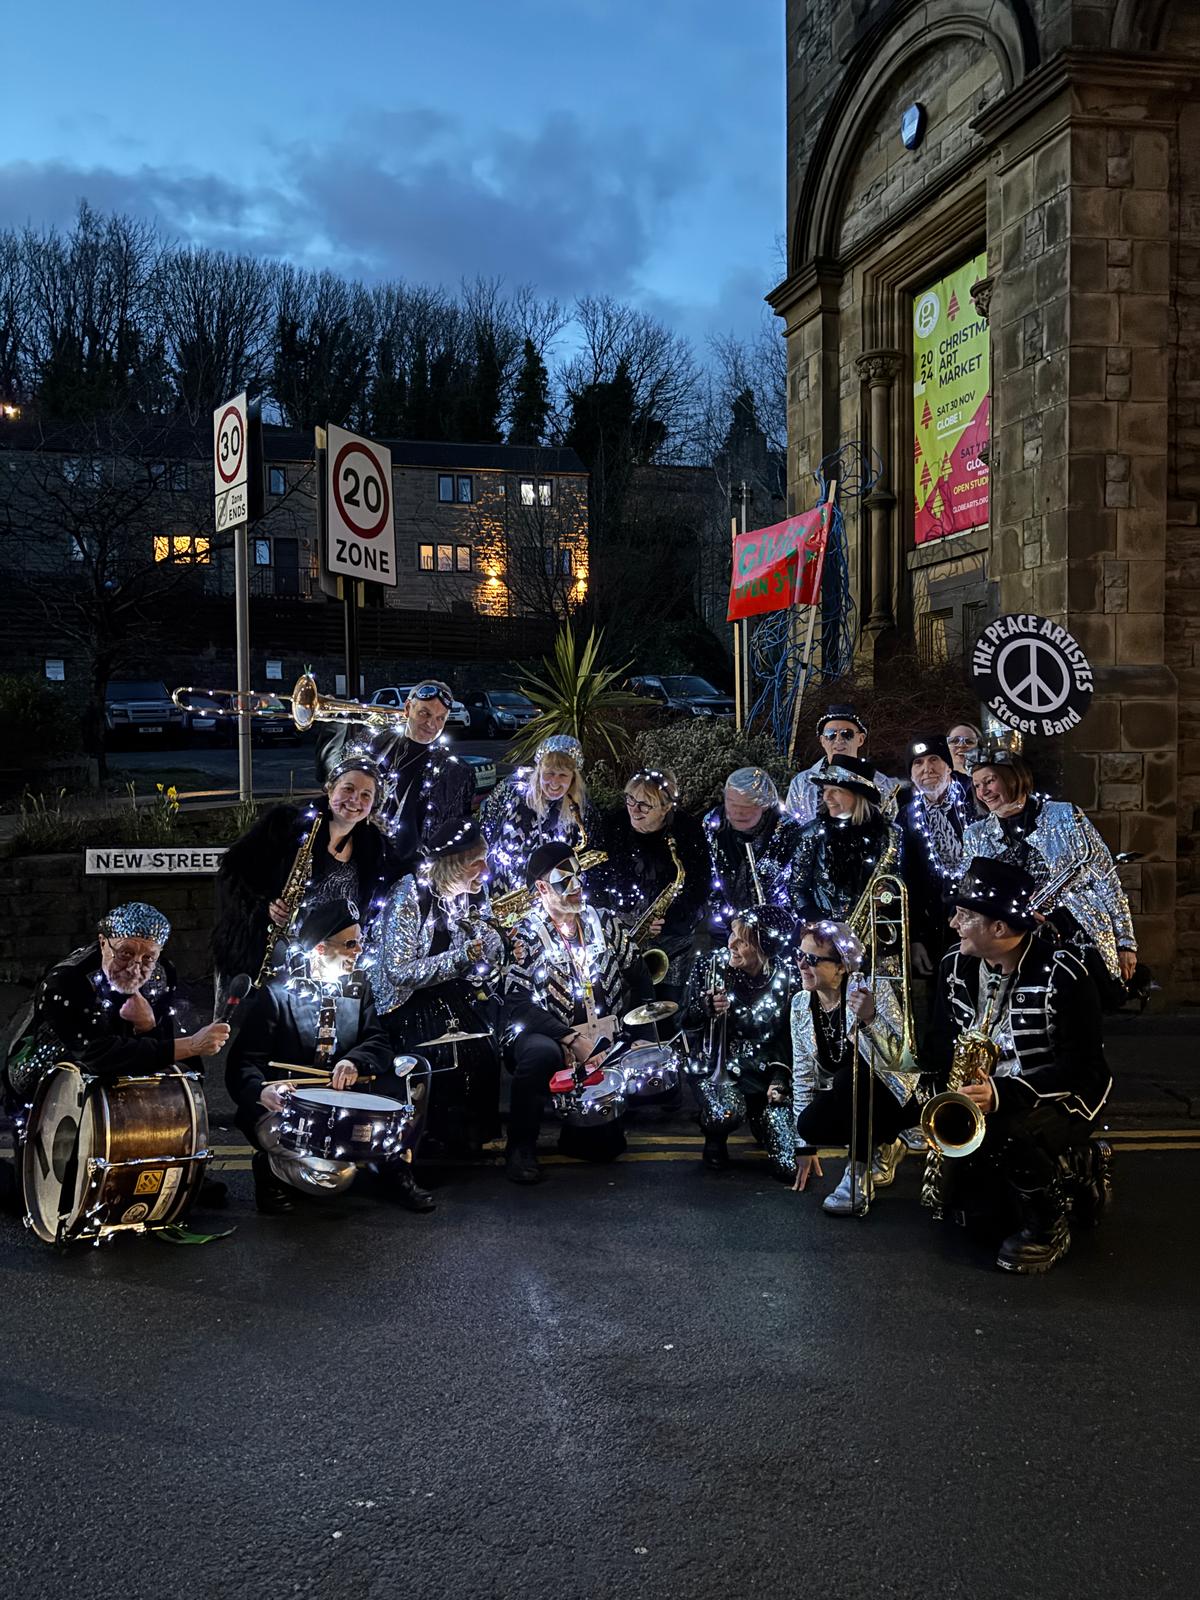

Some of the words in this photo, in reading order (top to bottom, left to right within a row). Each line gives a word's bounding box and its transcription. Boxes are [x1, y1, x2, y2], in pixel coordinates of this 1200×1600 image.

[920, 350, 934, 369] 20
[939, 350, 958, 372] ART
[939, 354, 983, 388] MARKET
[920, 366, 934, 385] 24
[937, 402, 950, 416] SAT
[950, 398, 959, 410] 30
[959, 390, 976, 407] NOV
[937, 413, 958, 431] GLOBE
[221, 425, 240, 462] 30
[960, 445, 975, 459] SAT
[231, 493, 243, 505] Zone
[343, 467, 382, 514] 20
[953, 481, 970, 495] OPEN
[229, 503, 246, 521] ENDS
[336, 538, 390, 574] ZONE
[984, 614, 1038, 645] PEACE
[973, 639, 996, 676] THE
[1039, 619, 1094, 693] ARTISTES
[988, 695, 1037, 735] Street
[1041, 706, 1082, 736] Band
[96, 854, 143, 869] NEW
